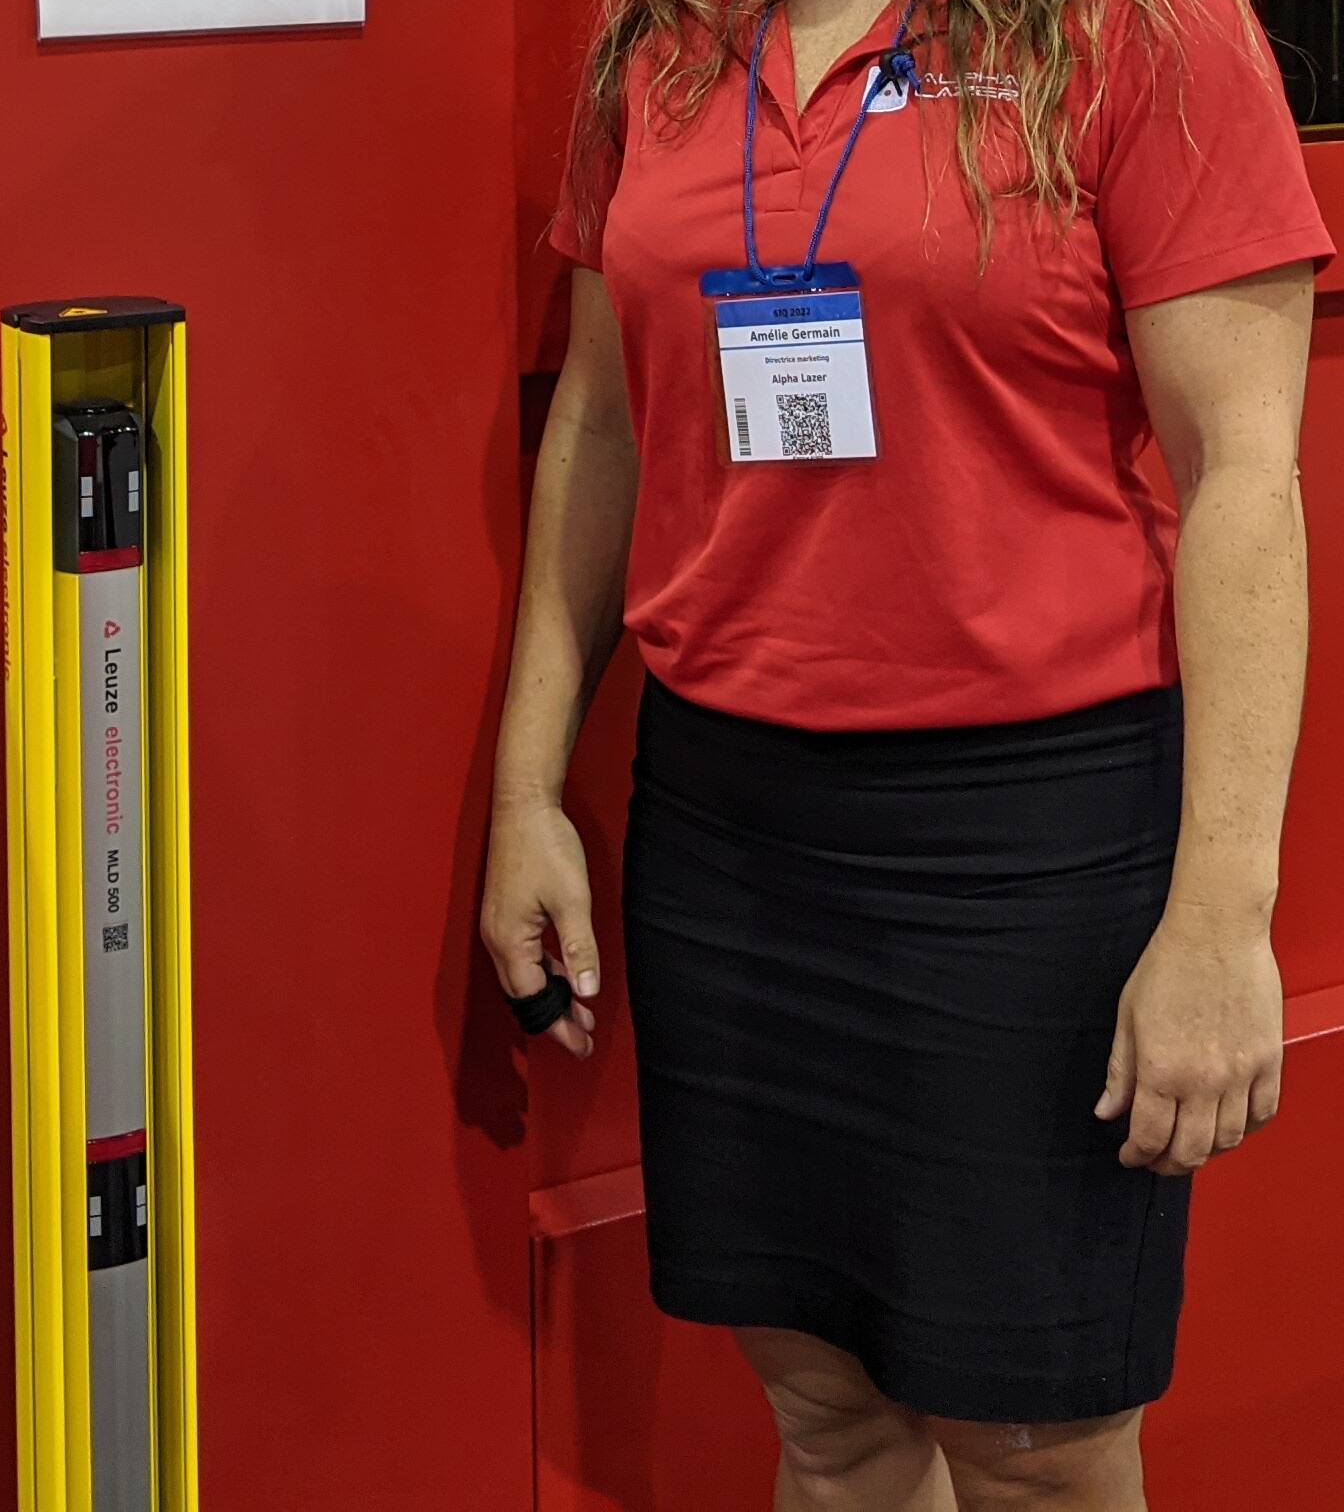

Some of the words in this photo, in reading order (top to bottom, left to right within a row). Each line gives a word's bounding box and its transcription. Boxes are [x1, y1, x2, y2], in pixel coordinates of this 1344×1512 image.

[750, 328, 789, 342] Amélie
[792, 326, 840, 340] Germain
[797, 354, 830, 363] marketing
[772, 375, 798, 385] Alpha
[801, 373, 827, 383] Lazer
[105, 648, 122, 714] Leuze
[105, 725, 123, 835] electronic
[106, 849, 120, 884] MLD
[107, 887, 120, 914] 500
